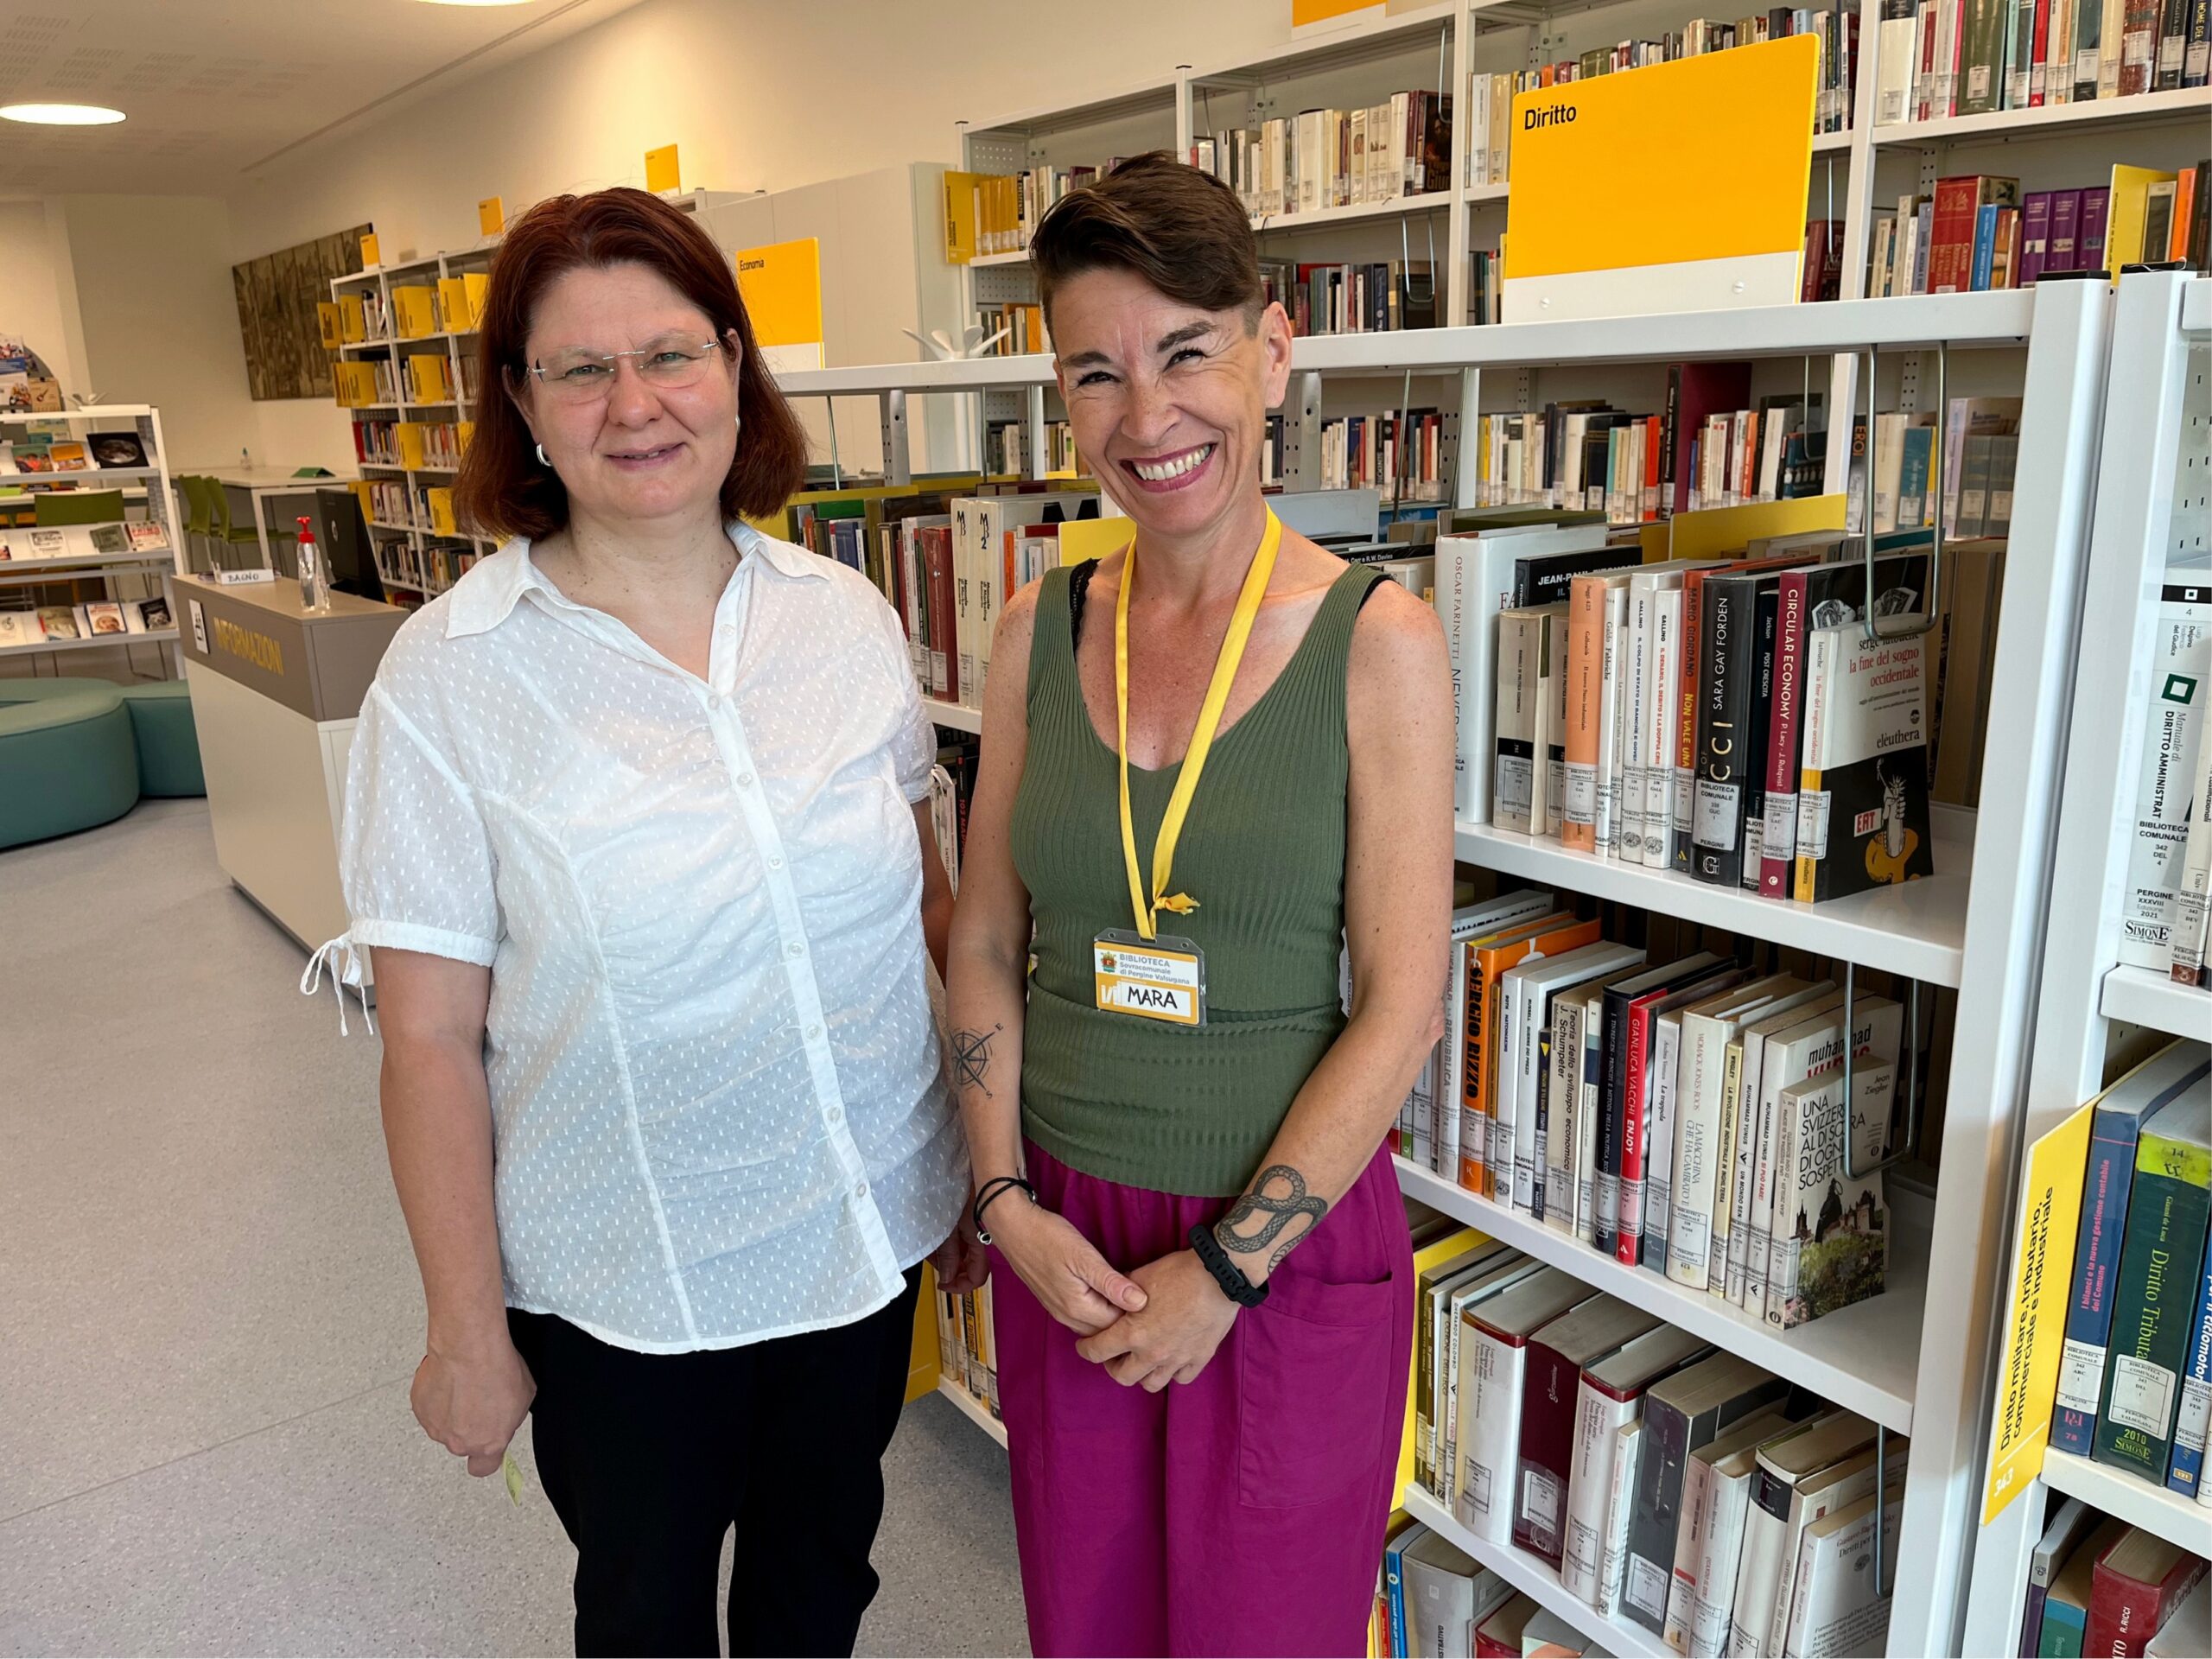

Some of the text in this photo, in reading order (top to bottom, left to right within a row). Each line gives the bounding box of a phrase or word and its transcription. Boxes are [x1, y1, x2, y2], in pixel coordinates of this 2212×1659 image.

[1524, 104, 1577, 130] Diritto
[740, 258, 765, 271] Economia
[228, 573, 260, 583] BAGNO
[1452, 556, 1463, 659] OSCAR FARINETTI
[1784, 589, 1799, 652] CIRCULAR
[1713, 597, 1729, 711] SARA GAY FORDEN
[2170, 635, 2179, 657] Giudice
[1850, 648, 1919, 673] la fine del sogno
[1681, 587, 1698, 767] MARIO GIORDANO NON VALE UNA
[1761, 669, 1770, 698] CRESCITA
[1780, 655, 1794, 720] ECONOMY
[1870, 665, 1919, 687] occidentale
[2161, 711, 2175, 751] DIRITTO
[2171, 711, 2187, 762] Manuale di
[1701, 782, 1735, 793] BIBLIOTECA
[1701, 791, 1733, 801] COMUNALE
[1857, 812, 1875, 832] EAT
[2139, 820, 2189, 833] BIBLIOTECA
[1700, 839, 1725, 849] PERGINE
[2139, 830, 2188, 843] COMUNALE
[2137, 888, 2174, 900] PERGINE
[2140, 910, 2158, 919] 2021
[1119, 953, 1170, 968] BIBLIOTECA
[1119, 963, 1171, 975] Sovracomunale
[1128, 969, 1154, 979] Pergine
[1155, 973, 1190, 985] Valsugana
[1127, 985, 1178, 1009] MARA
[1466, 967, 1484, 1098] SERGIO RIZZO
[1557, 1006, 1568, 1079] J. Schumpeter
[1443, 1019, 1452, 1087] REPUBBLICA
[1563, 1009, 1578, 1171] Teoria dello sviluppo economico
[1625, 1018, 1640, 1155] GIANLUCA VACCHI ENJOY
[1865, 1083, 1888, 1096] Ziegler
[1874, 1073, 1890, 1084] Jean
[1745, 1084, 1753, 1122] MUHAMMAD
[1803, 1094, 1829, 1119] UNA
[1686, 1120, 1695, 1138] CHE
[1764, 1102, 1772, 1139] MUHAMMAD
[1801, 1102, 1847, 1137] SVIZZER
[1800, 1112, 1866, 1155] AL DI SORA
[1685, 1139, 1694, 1154] HA
[1692, 1123, 1704, 1184] LA MACCHINA
[1800, 1140, 1845, 1174] DI OGNI
[2171, 1147, 2184, 1158] 14
[1740, 1171, 1746, 1180] UN
[1798, 1155, 1845, 1191] SOSPETT
[2082, 1279, 2092, 1304] bilanci
[2089, 1236, 2099, 1262] nuova
[2013, 1186, 2054, 1440] commerciale e industriale
[2135, 1248, 2171, 1360] Diritto Tributa
[2001, 1202, 2044, 1452] Diritto militare, tributario,
[2124, 1429, 2148, 1445] 2010
